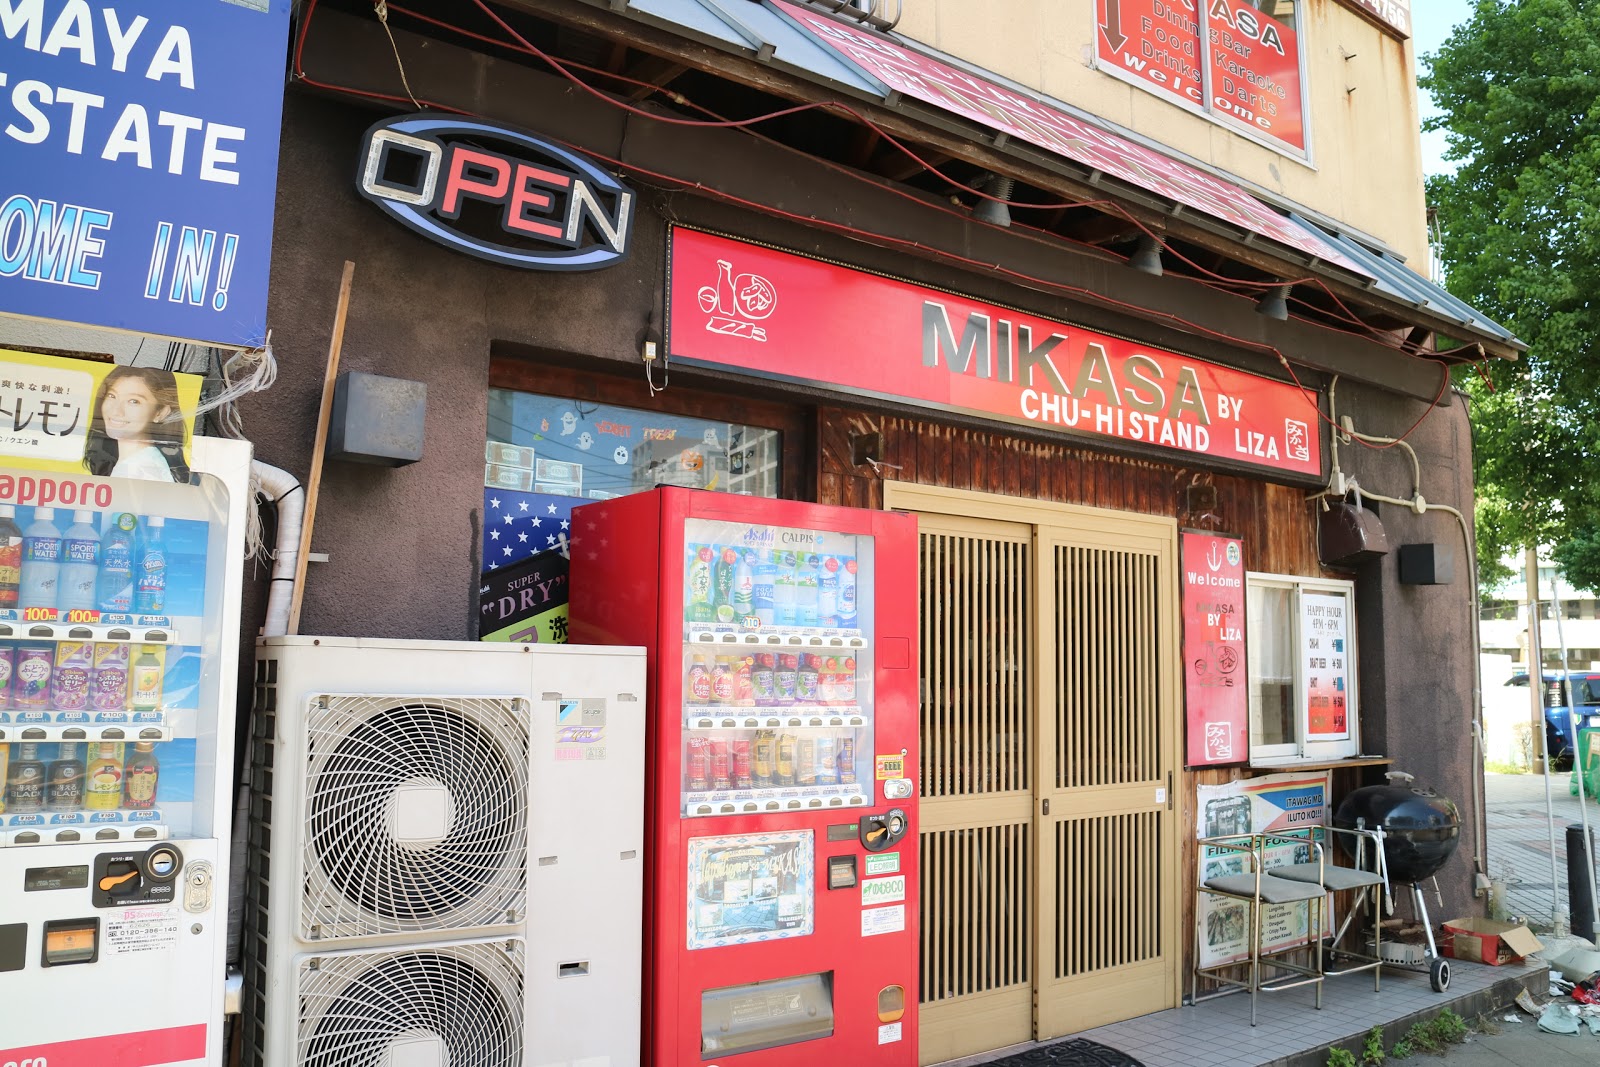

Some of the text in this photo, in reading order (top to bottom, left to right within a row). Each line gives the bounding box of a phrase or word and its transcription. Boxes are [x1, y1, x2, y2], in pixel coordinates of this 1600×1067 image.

[1141, 16, 1194, 56] Food
[1181, 0, 1285, 55] ASA
[1221, 32, 1251, 58] Bar
[1141, 39, 1202, 82] Drinks
[1215, 50, 1287, 99] Karaoke
[1223, 77, 1277, 116] Darts
[0, 72, 246, 185] STATE
[362, 128, 632, 253] OPEN
[144, 221, 240, 311] IN!
[922, 300, 1212, 426] MIKASA
[1020, 389, 1210, 452] CHU-HI STAND
[1217, 394, 1244, 422] BY
[1234, 428, 1280, 461] LIZA
[1287, 420, 1309, 460] みかさ
[34, 542, 59, 551] SPORTS
[70, 544, 95, 552] SPORTS
[743, 528, 814, 544] Asahi CALPIS
[34, 550, 57, 558] WATER
[70, 552, 93, 560] WATER
[507, 572, 541, 591] SUPER
[1188, 571, 1241, 588] Welcome
[1207, 613, 1221, 627] BY
[1307, 605, 1343, 618] HAPPY HOUR
[1312, 618, 1324, 629] 4PM
[1327, 619, 1339, 631] 6PM
[1220, 628, 1242, 642] LIZA
[1286, 794, 1323, 808] ITAWAG MO
[1287, 809, 1322, 822] ILUTO KO!!!
